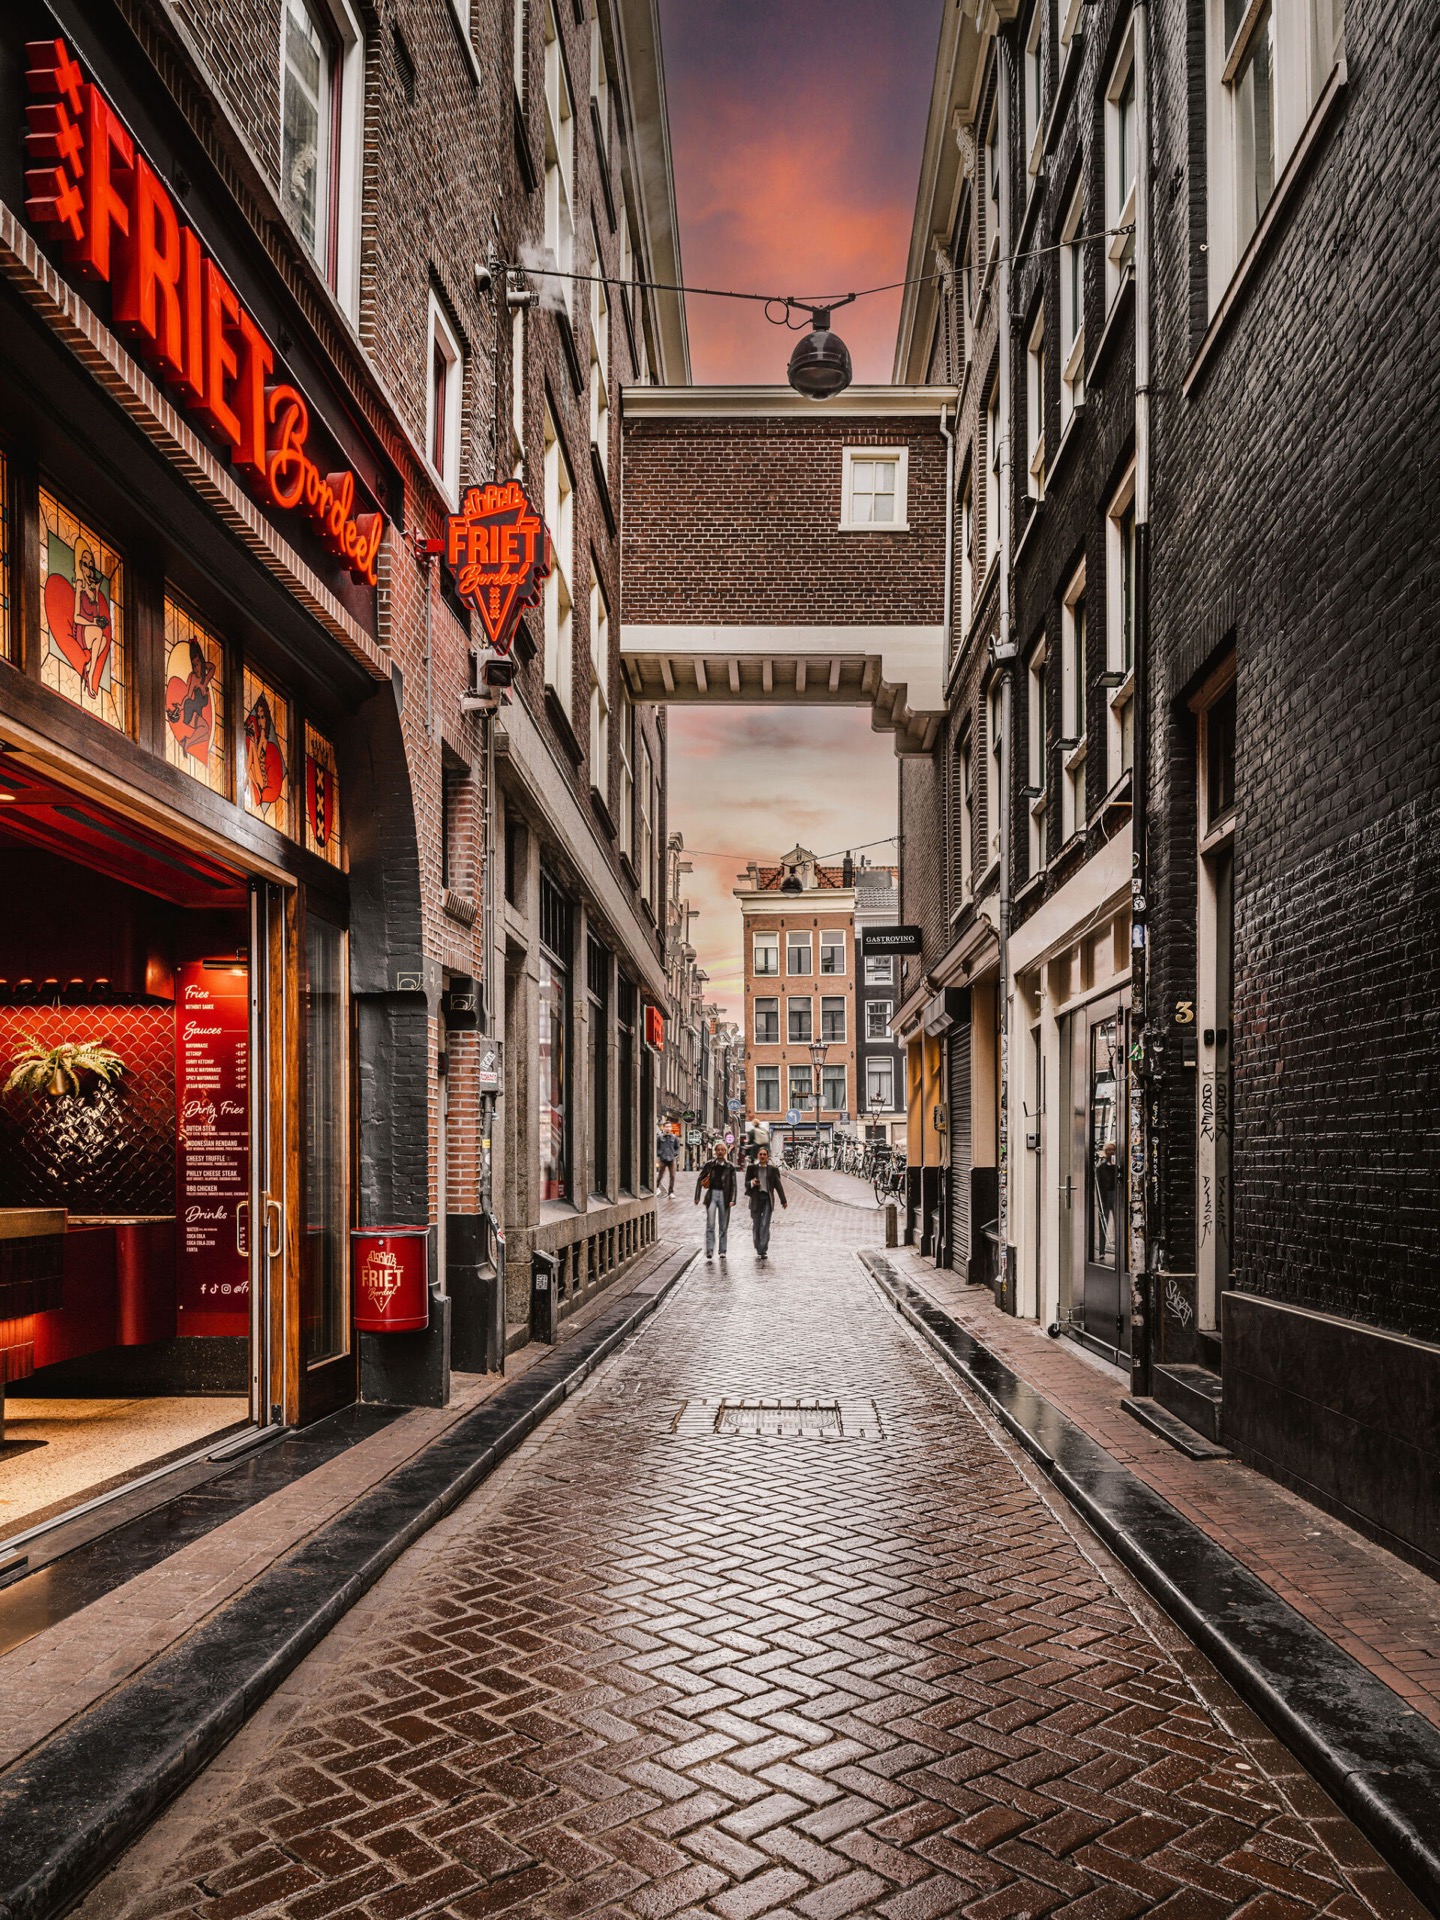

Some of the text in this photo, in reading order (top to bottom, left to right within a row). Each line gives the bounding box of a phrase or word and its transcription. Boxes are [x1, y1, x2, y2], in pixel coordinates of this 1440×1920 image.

[82, 82, 384, 586] FRIET Bordeel
[449, 525, 541, 565] FRIET
[459, 563, 531, 594] Bordeel
[865, 935, 915, 943] GASTROVINO
[185, 984, 209, 1000] Fries
[1175, 1001, 1194, 1023] 3
[183, 1020, 222, 1041] Sauces
[185, 1100, 245, 1124] Dirty Fries
[184, 1205, 228, 1223] Drinks
[362, 1269, 404, 1287] FRIET
[368, 1285, 398, 1300] Bordeel
